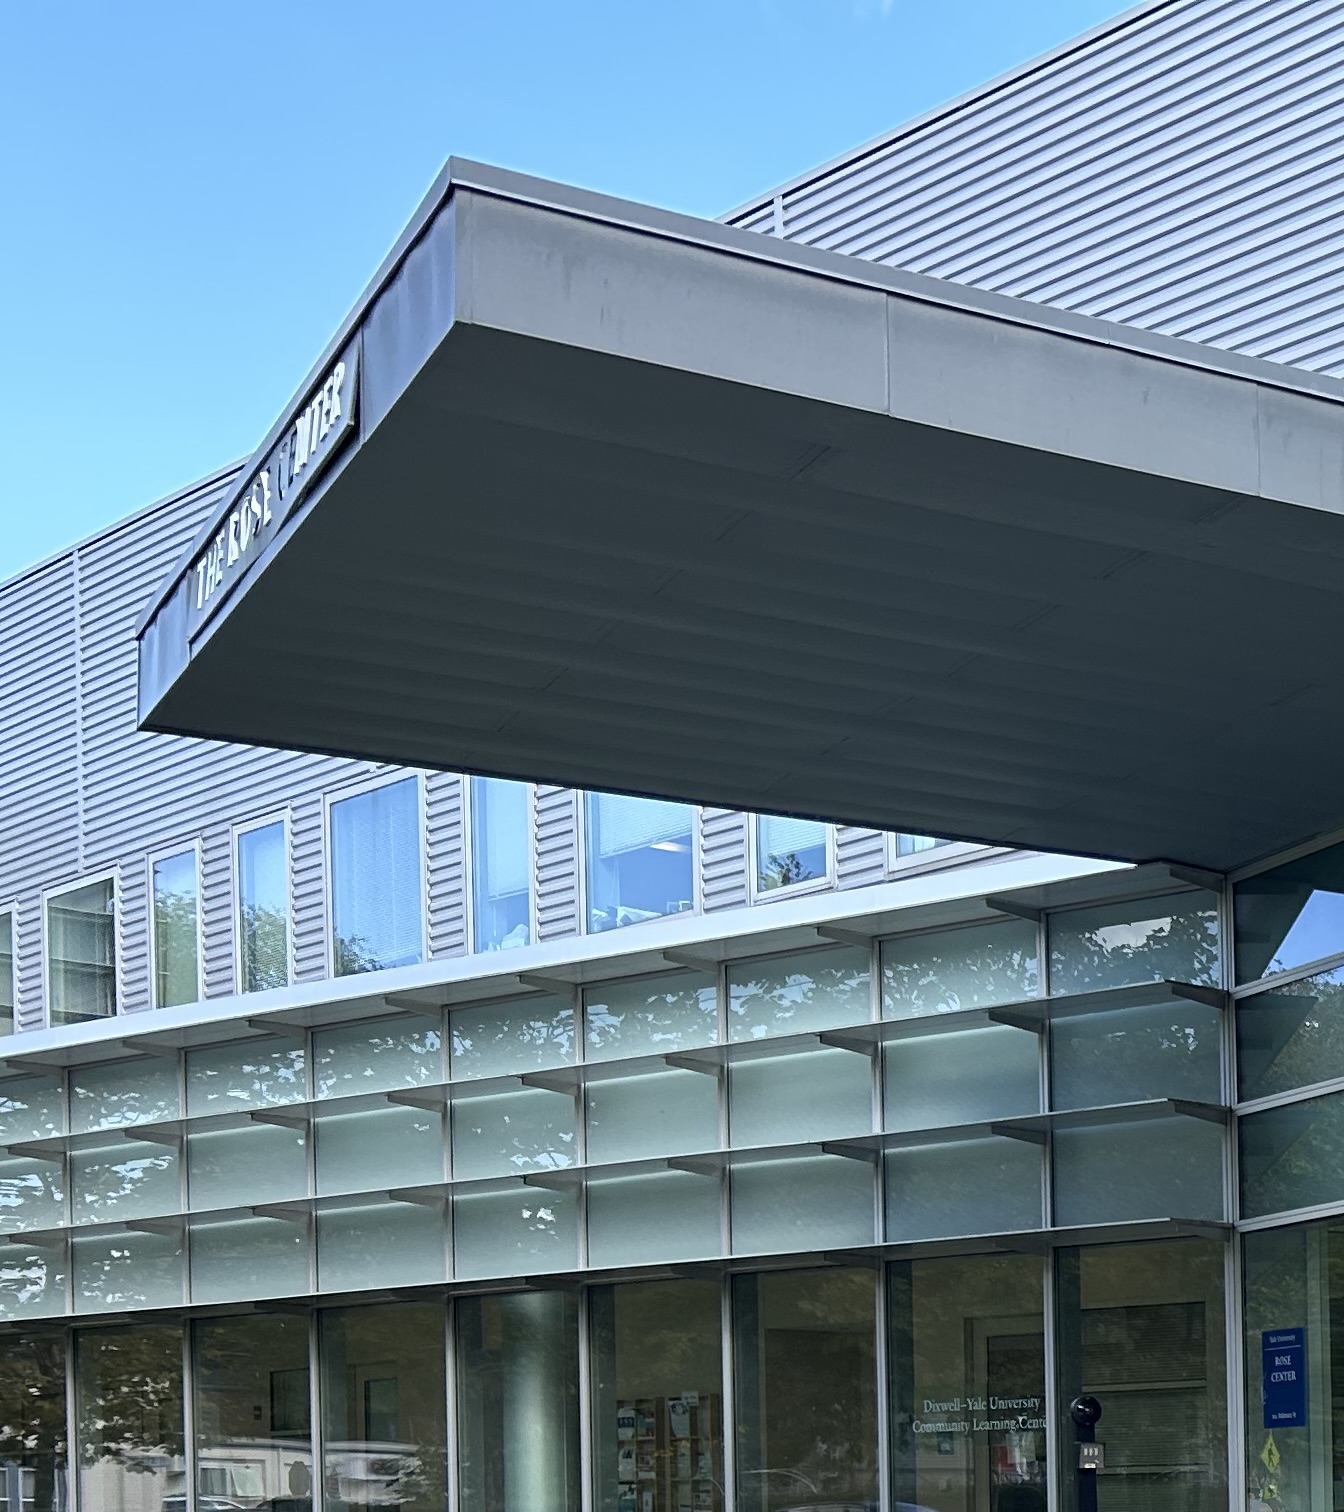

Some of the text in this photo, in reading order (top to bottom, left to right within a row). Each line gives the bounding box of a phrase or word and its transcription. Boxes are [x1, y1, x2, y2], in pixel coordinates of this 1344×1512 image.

[197, 529, 226, 608] THE
[227, 468, 273, 568] ROSE
[1275, 1355, 1291, 1366] ROSE
[1271, 1371, 1296, 1382] CENTER
[989, 1395, 1040, 1411] University
[912, 1419, 970, 1434] Community
[973, 1417, 1017, 1433] Learning
